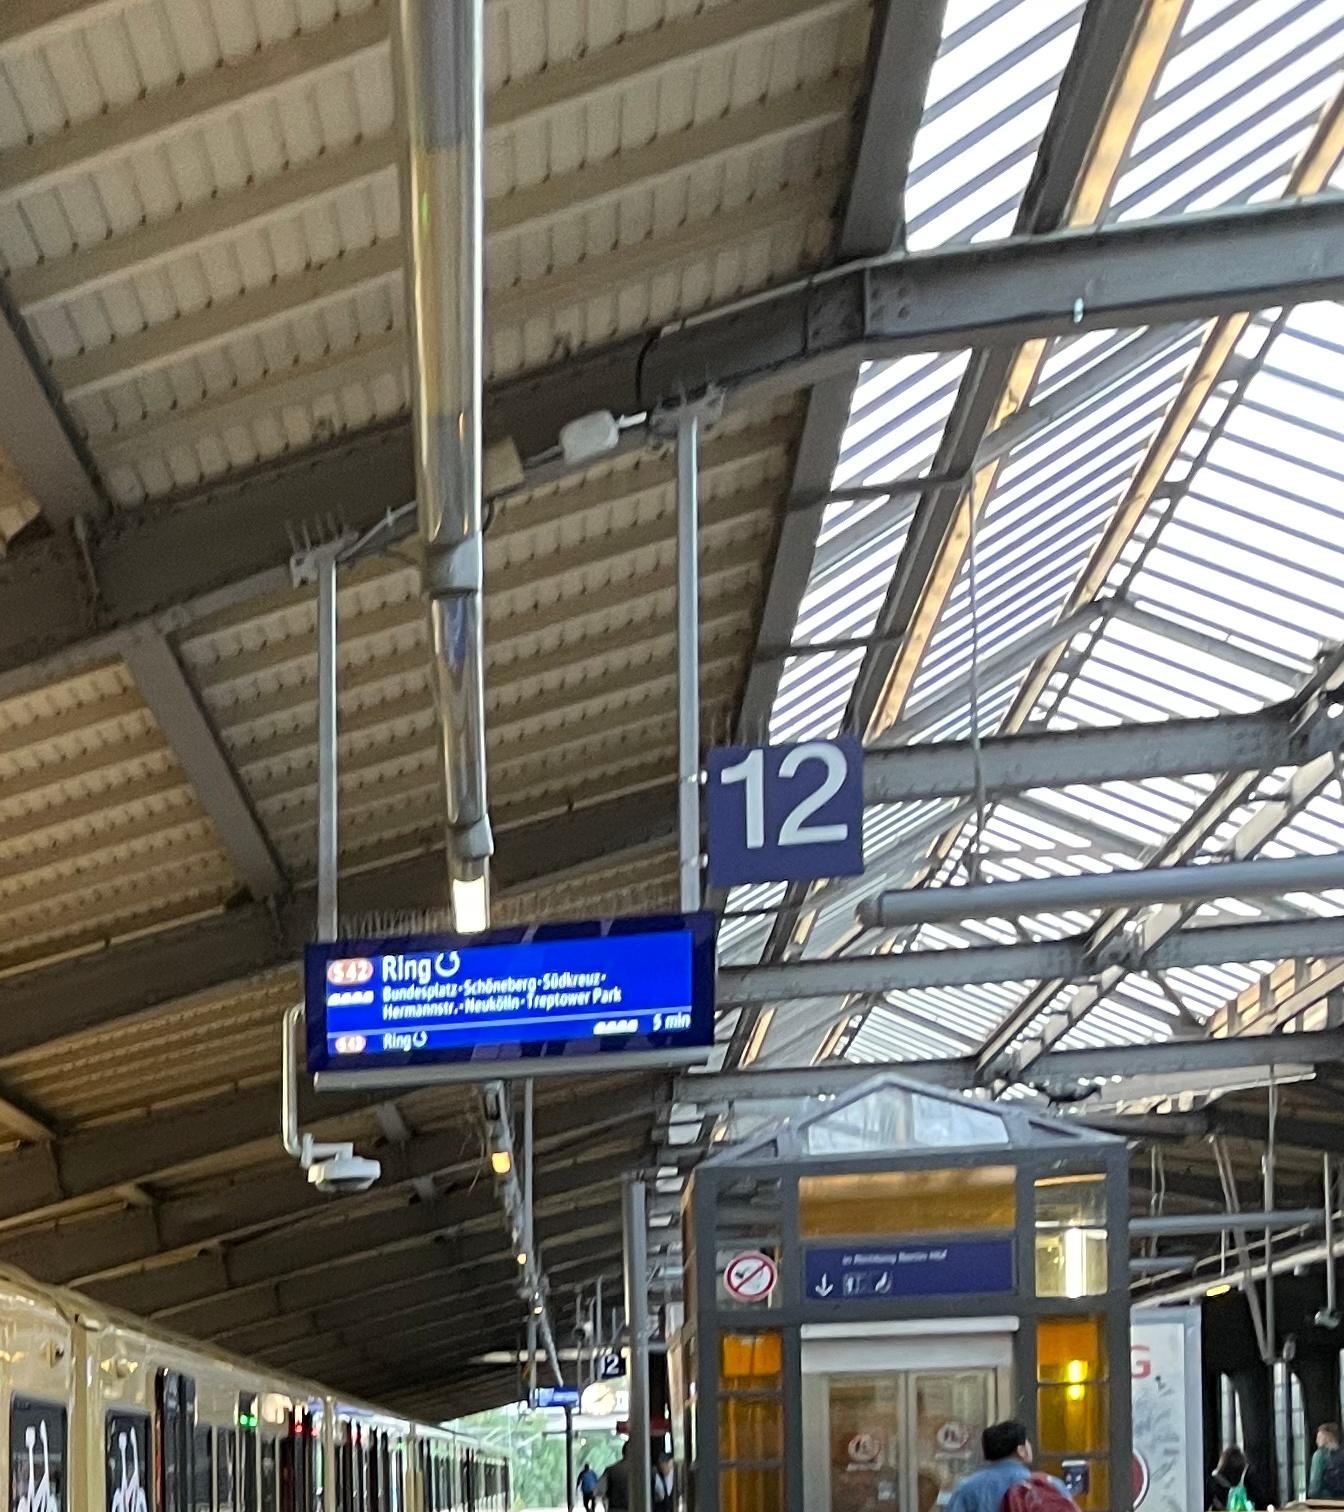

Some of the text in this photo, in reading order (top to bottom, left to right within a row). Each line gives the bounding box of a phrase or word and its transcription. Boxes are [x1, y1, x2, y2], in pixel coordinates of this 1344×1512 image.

[721, 742, 848, 849] 12
[382, 955, 431, 984] Ring
[592, 986, 622, 1005] Park
[665, 1011, 692, 1031] min
[382, 1032, 412, 1052] Ring
